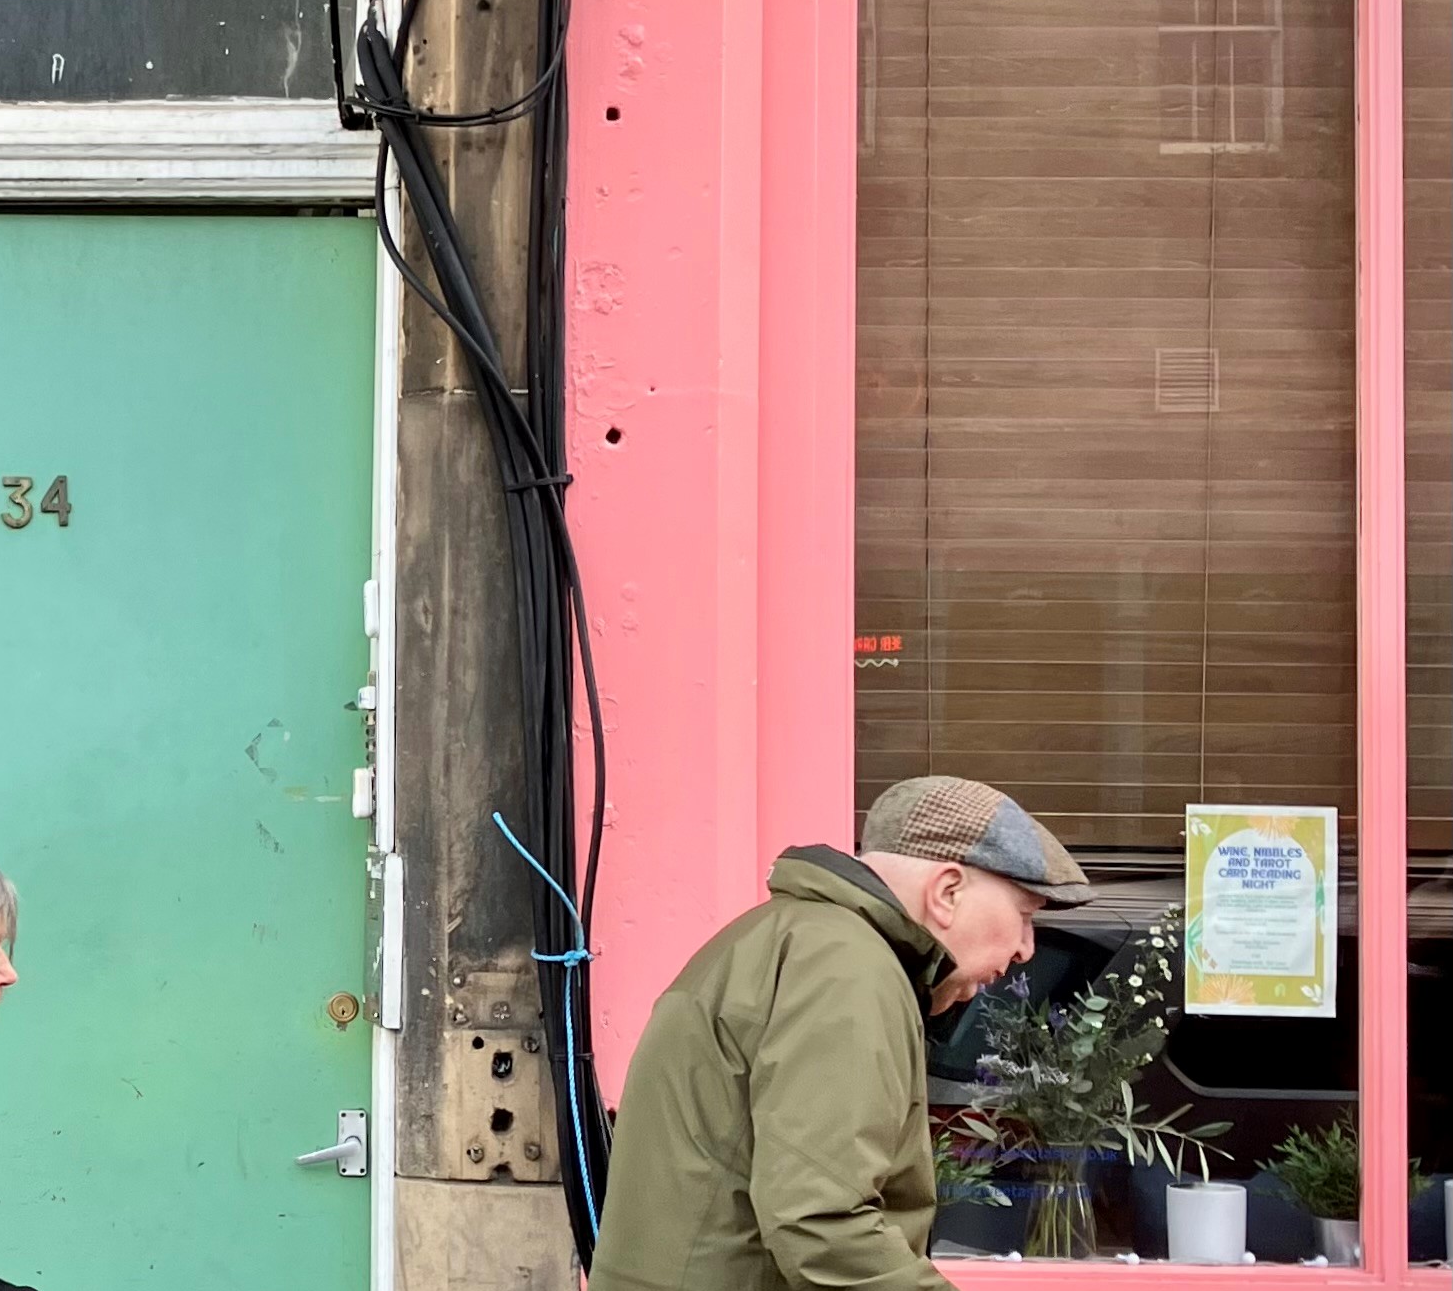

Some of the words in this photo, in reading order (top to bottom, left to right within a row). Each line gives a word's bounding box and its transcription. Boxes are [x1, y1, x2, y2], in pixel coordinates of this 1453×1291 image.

[1, 475, 72, 529] 34
[1228, 857, 1250, 867] AND
[1254, 858, 1292, 868] TAROT
[1218, 868, 1248, 878] CARD
[1251, 869, 1301, 880] READING
[1242, 880, 1276, 890] NIGHT
